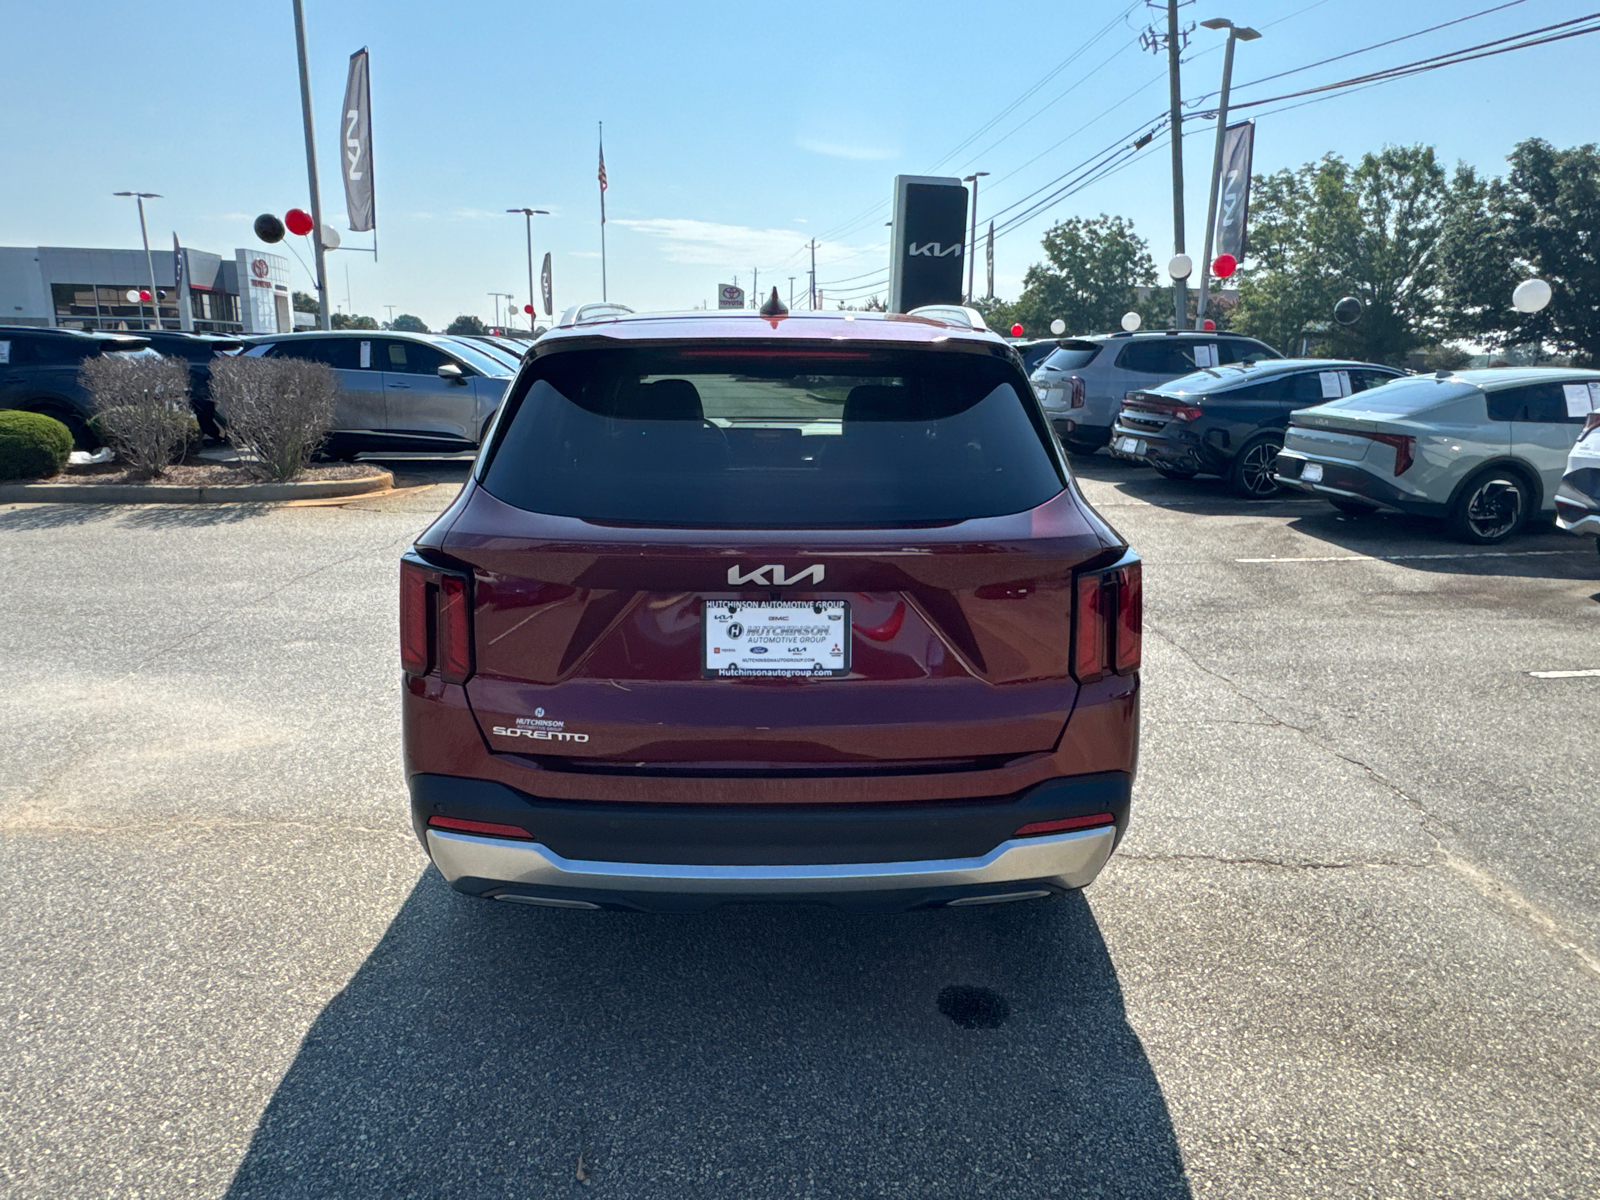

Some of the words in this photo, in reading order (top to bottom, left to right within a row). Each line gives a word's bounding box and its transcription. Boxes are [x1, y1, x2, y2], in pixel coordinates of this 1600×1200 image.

[909, 242, 961, 257] KIA
[727, 564, 825, 585] KIA
[706, 601, 759, 609] HUTCHINSON
[761, 601, 814, 609] AUTOMOTIVE
[815, 601, 845, 609] GROUP
[746, 625, 830, 637] HUTCHINSON
[747, 636, 798, 644] AUTOMOTIVE
[718, 668, 833, 677] Hutchinsonautogroup.com
[515, 718, 564, 727] HUTCHINSON
[492, 726, 589, 743] SORENTO
